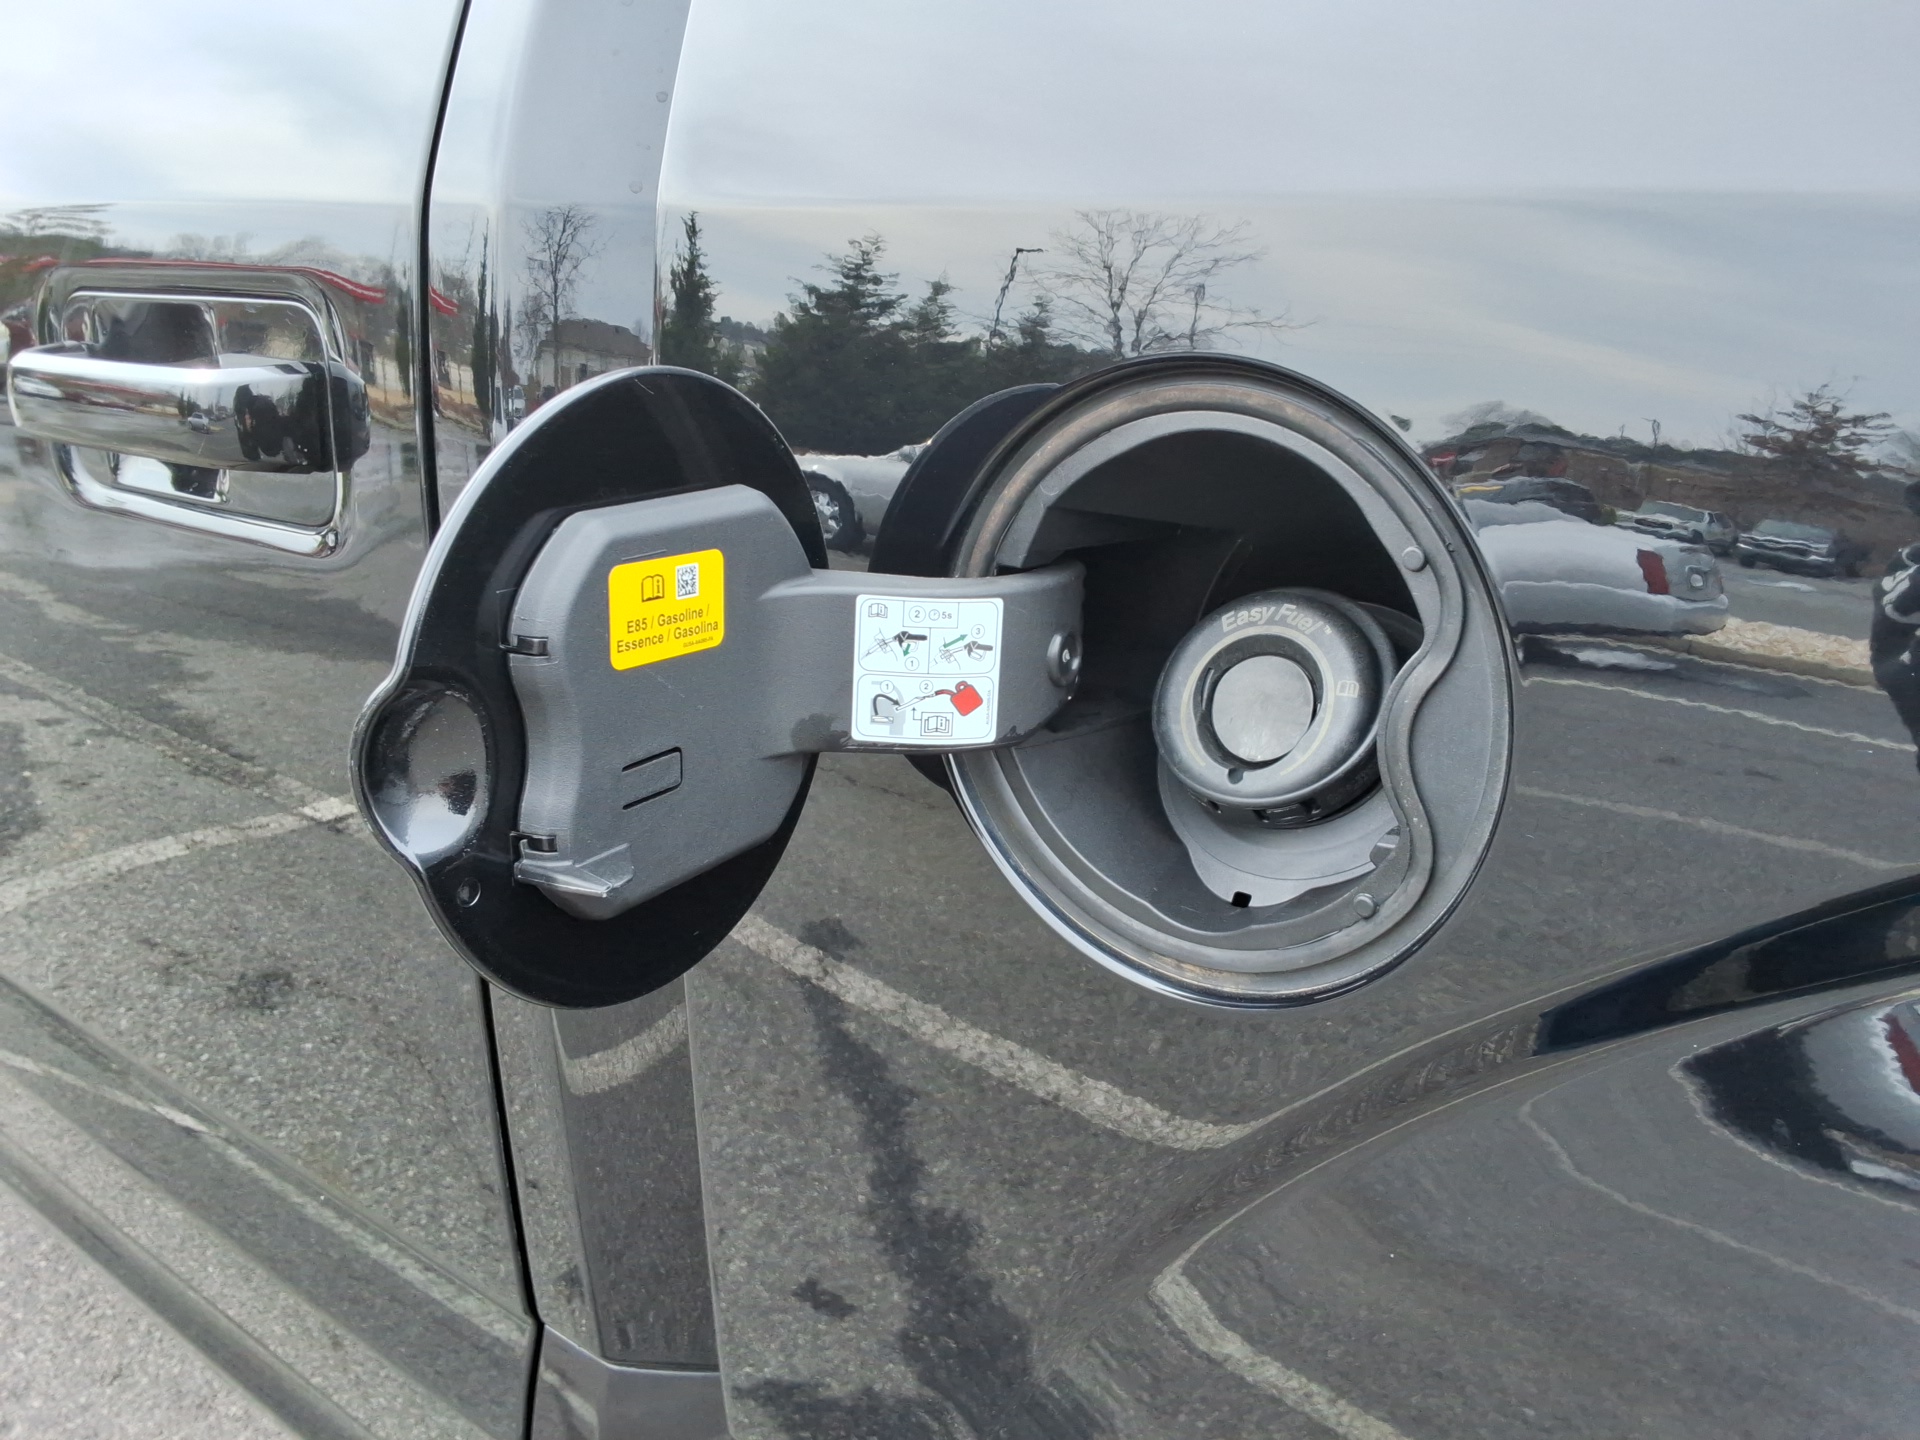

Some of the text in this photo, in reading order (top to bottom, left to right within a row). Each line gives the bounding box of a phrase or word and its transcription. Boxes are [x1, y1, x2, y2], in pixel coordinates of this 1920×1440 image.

[627, 617, 648, 634] E85
[657, 607, 704, 627] Gasoline
[914, 610, 920, 618] 2
[941, 611, 953, 620] 5s
[1221, 605, 1276, 633] Easy
[617, 633, 664, 654] Essence
[673, 620, 719, 640] Gasolina
